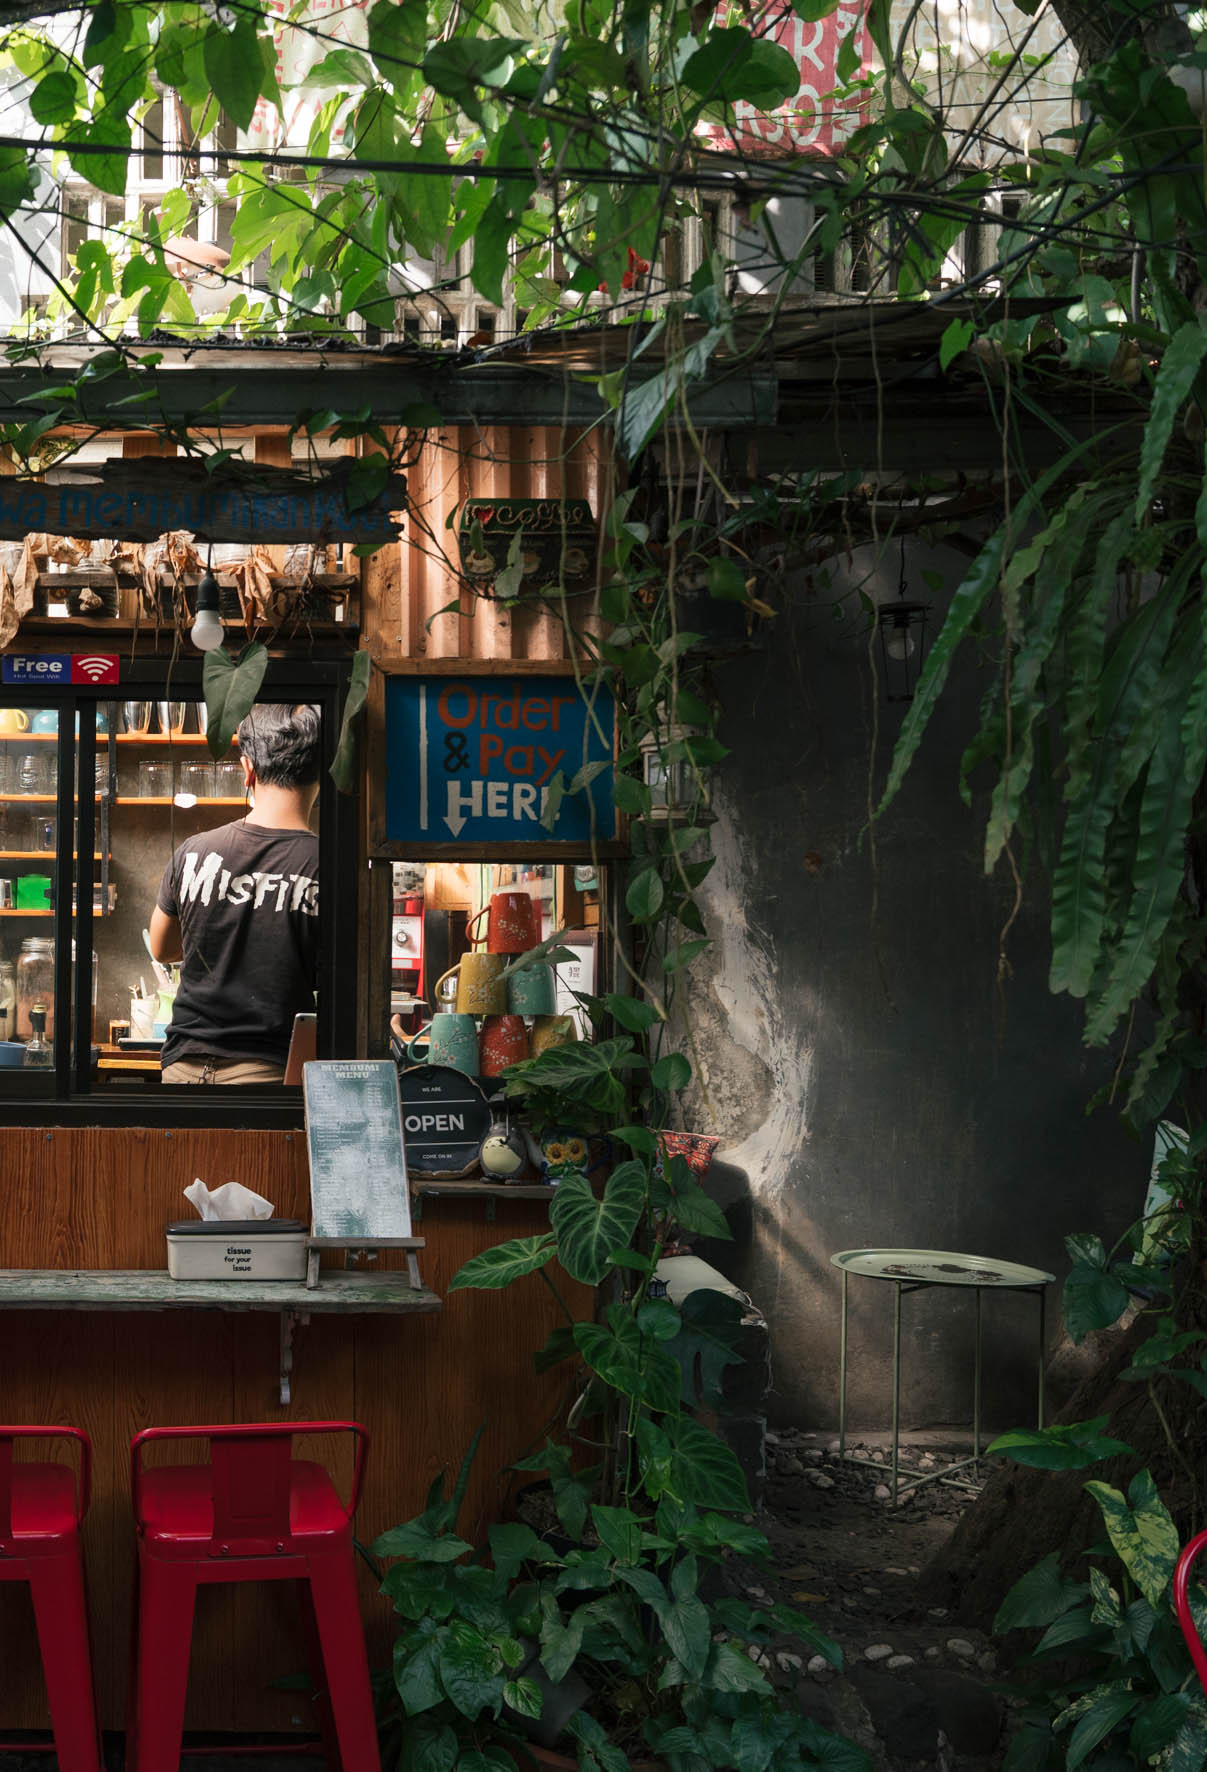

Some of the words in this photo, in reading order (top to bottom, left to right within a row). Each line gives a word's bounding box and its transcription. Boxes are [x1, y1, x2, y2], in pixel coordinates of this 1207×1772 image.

[13, 658, 62, 672] Free
[437, 683, 575, 731] Order
[443, 731, 470, 773] &
[479, 733, 566, 786] Pay
[405, 1114, 464, 1132] OPEN
